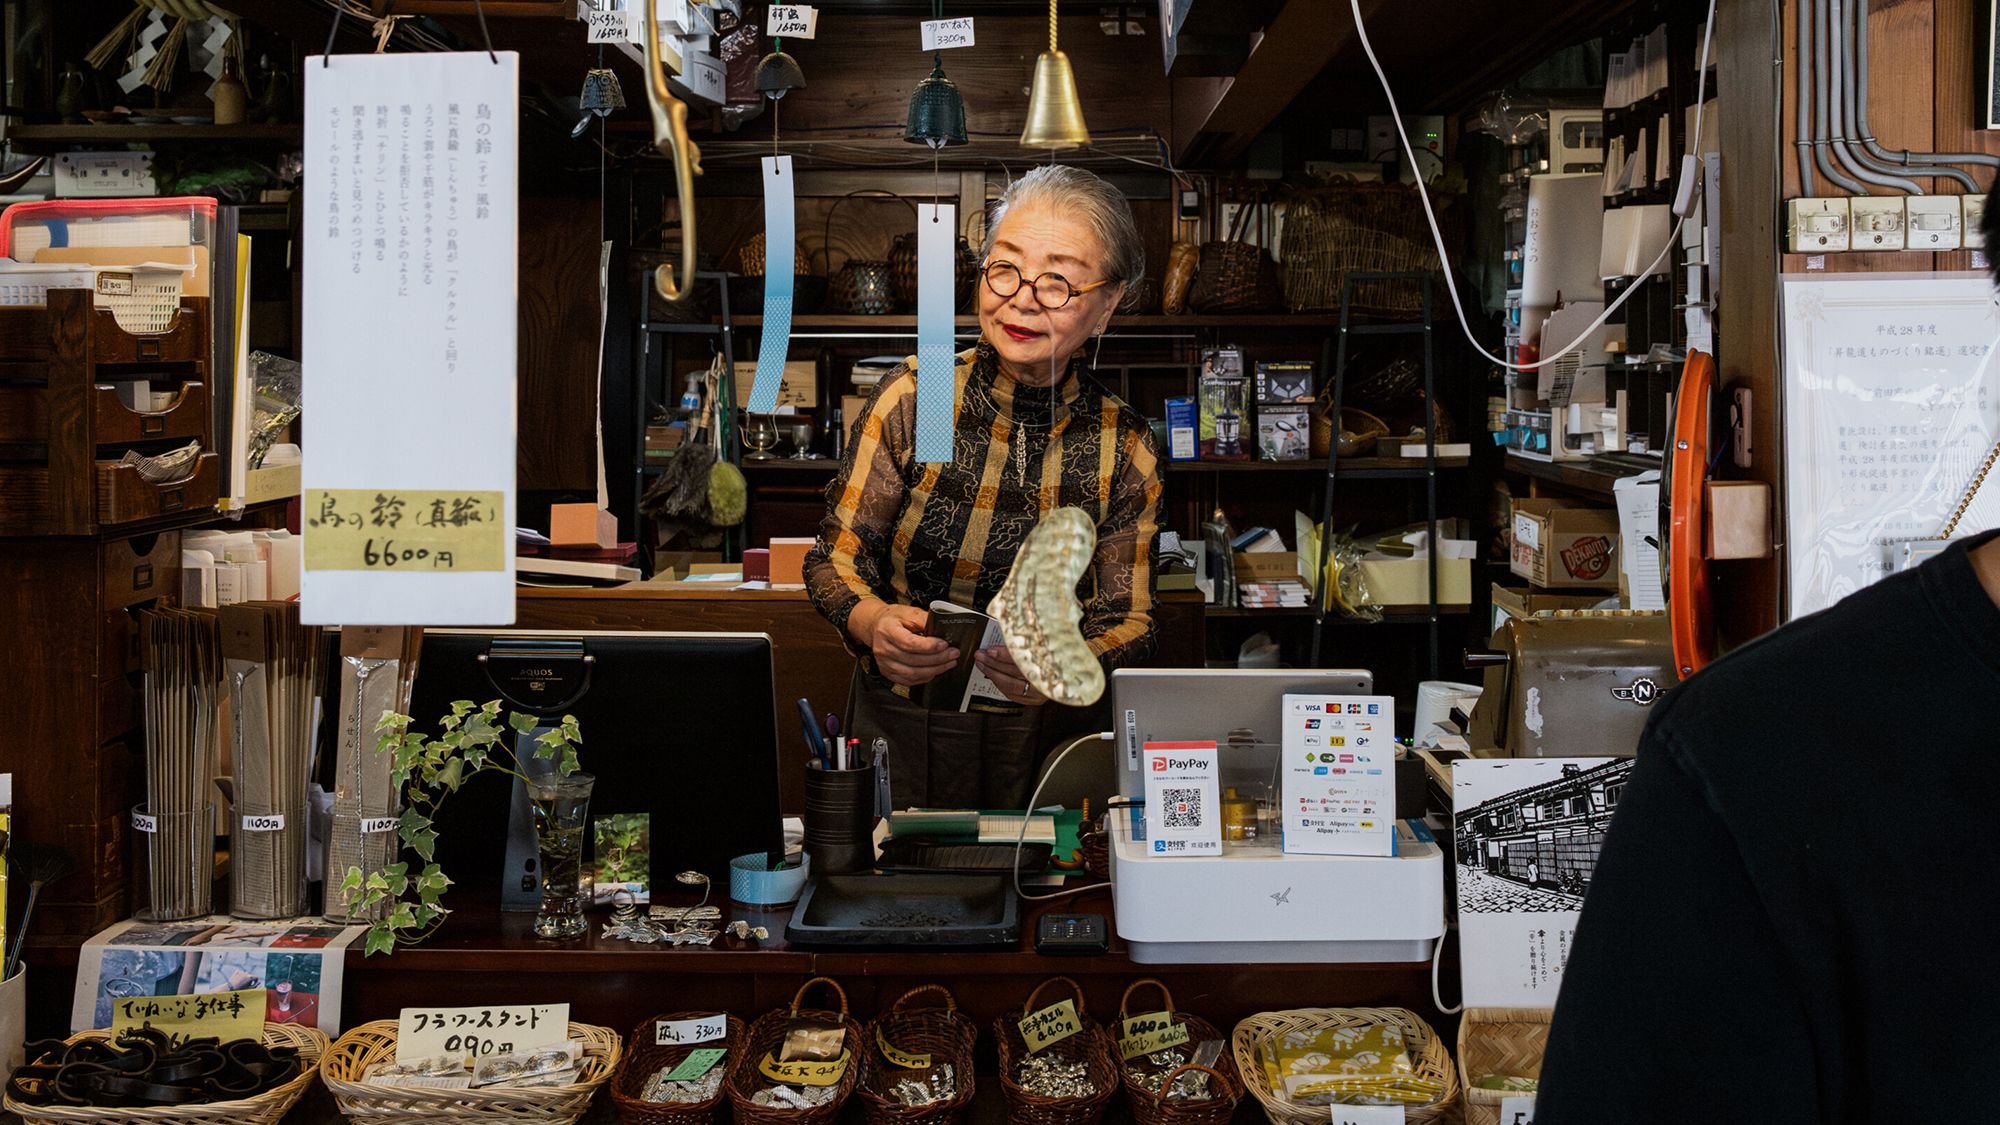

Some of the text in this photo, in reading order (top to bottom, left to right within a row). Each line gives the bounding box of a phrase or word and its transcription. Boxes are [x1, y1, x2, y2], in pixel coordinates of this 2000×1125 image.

[595, 28, 623, 39] 1650円
[776, 23, 807, 33] 1650円
[937, 34, 966, 45] 3300円
[364, 538, 453, 568] 6600円
[520, 668, 553, 677] AQUOS
[1638, 685, 1651, 698] N
[345, 713, 356, 749] らせん
[1169, 759, 1209, 770] PayPay
[247, 818, 278, 829] 1100円
[413, 1007, 549, 1033] フラワースタンド
[695, 1024, 722, 1040] 330円
[1037, 1021, 1073, 1042] 440円
